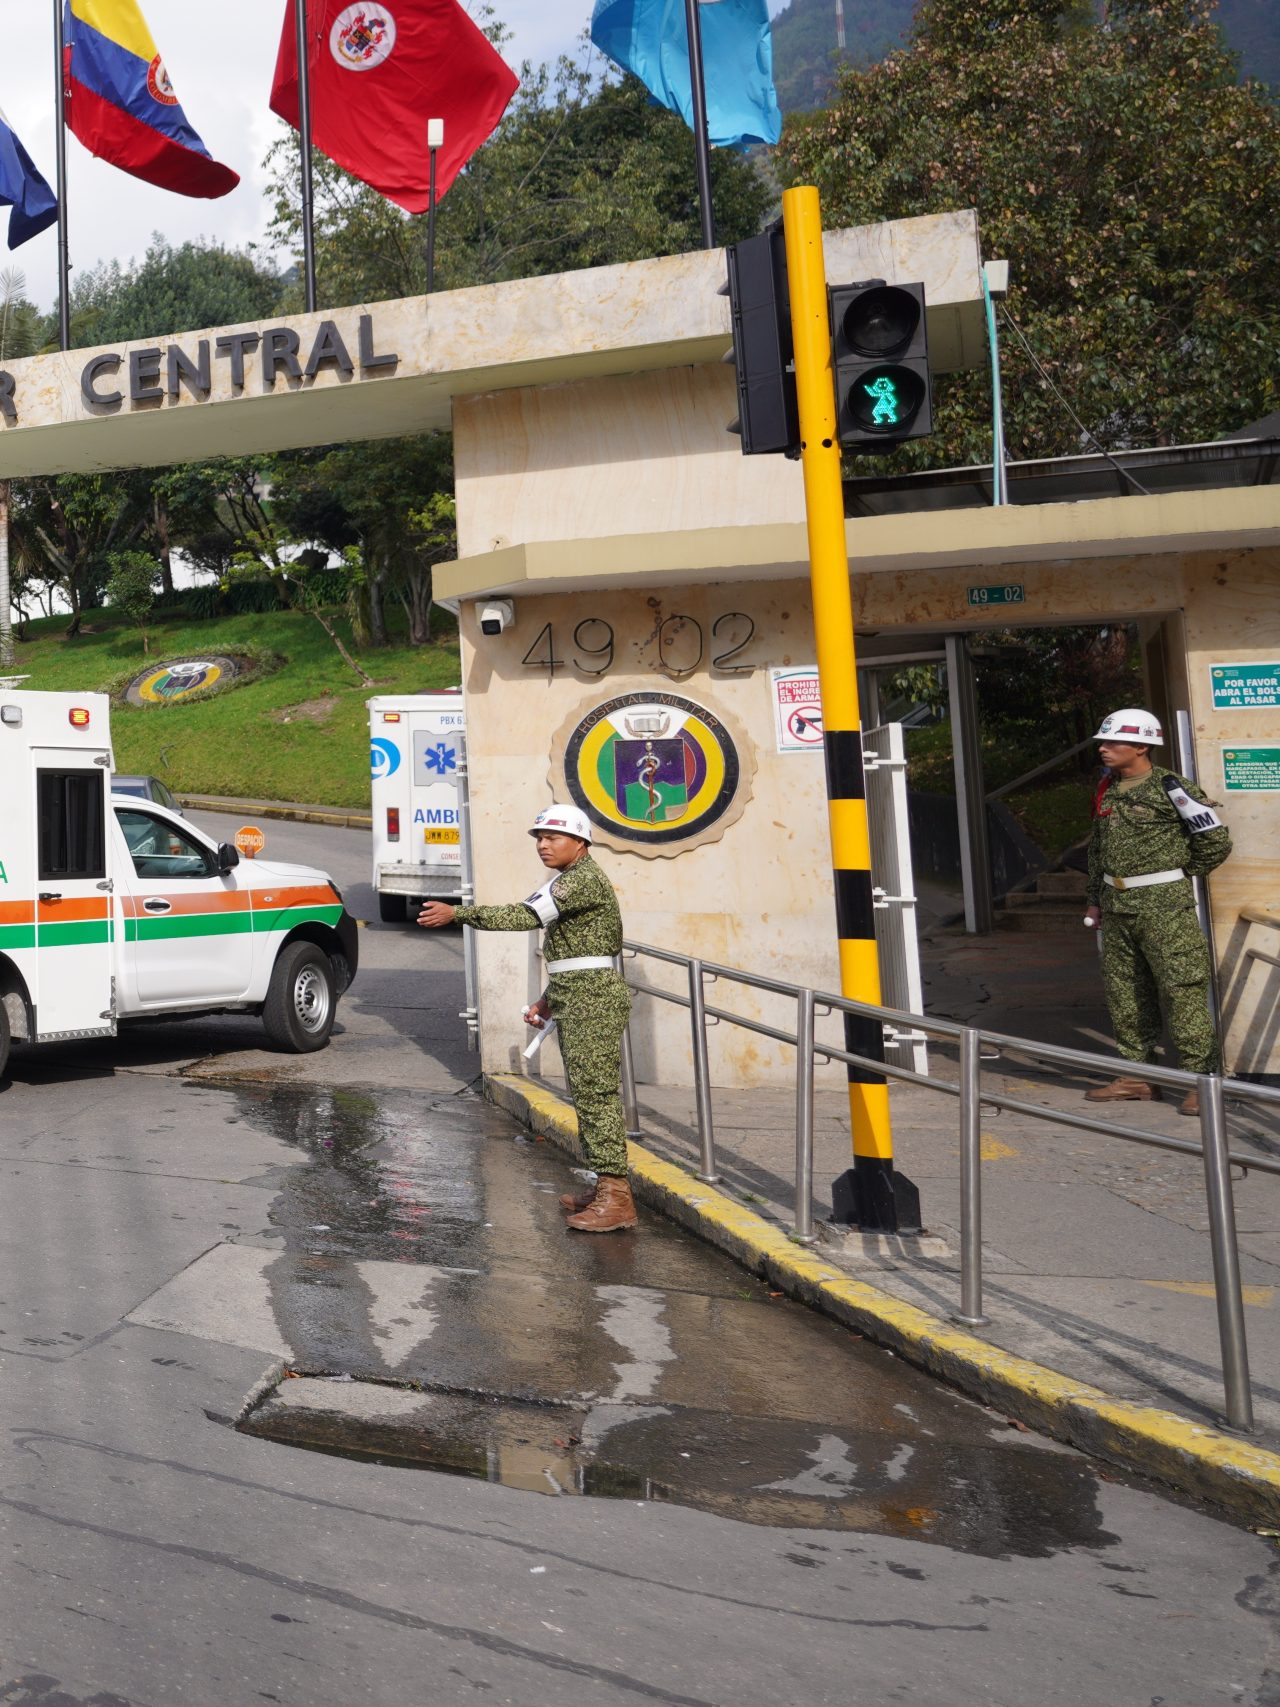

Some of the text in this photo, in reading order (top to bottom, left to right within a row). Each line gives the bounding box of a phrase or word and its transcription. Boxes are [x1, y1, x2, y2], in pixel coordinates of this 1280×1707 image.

[80, 313, 400, 405] CENTRAL
[972, 588, 988, 603] 49
[1004, 587, 1021, 601] 02
[1224, 678, 1278, 688] POR FAVOR
[1214, 688, 1241, 697] ABRA
[1243, 688, 1255, 696] EL
[1230, 695, 1276, 705] AL PASAR
[578, 694, 719, 734] HOSPITAL MILITAR
[440, 716, 455, 725] PBX
[237, 834, 263, 847] DESPACIO
